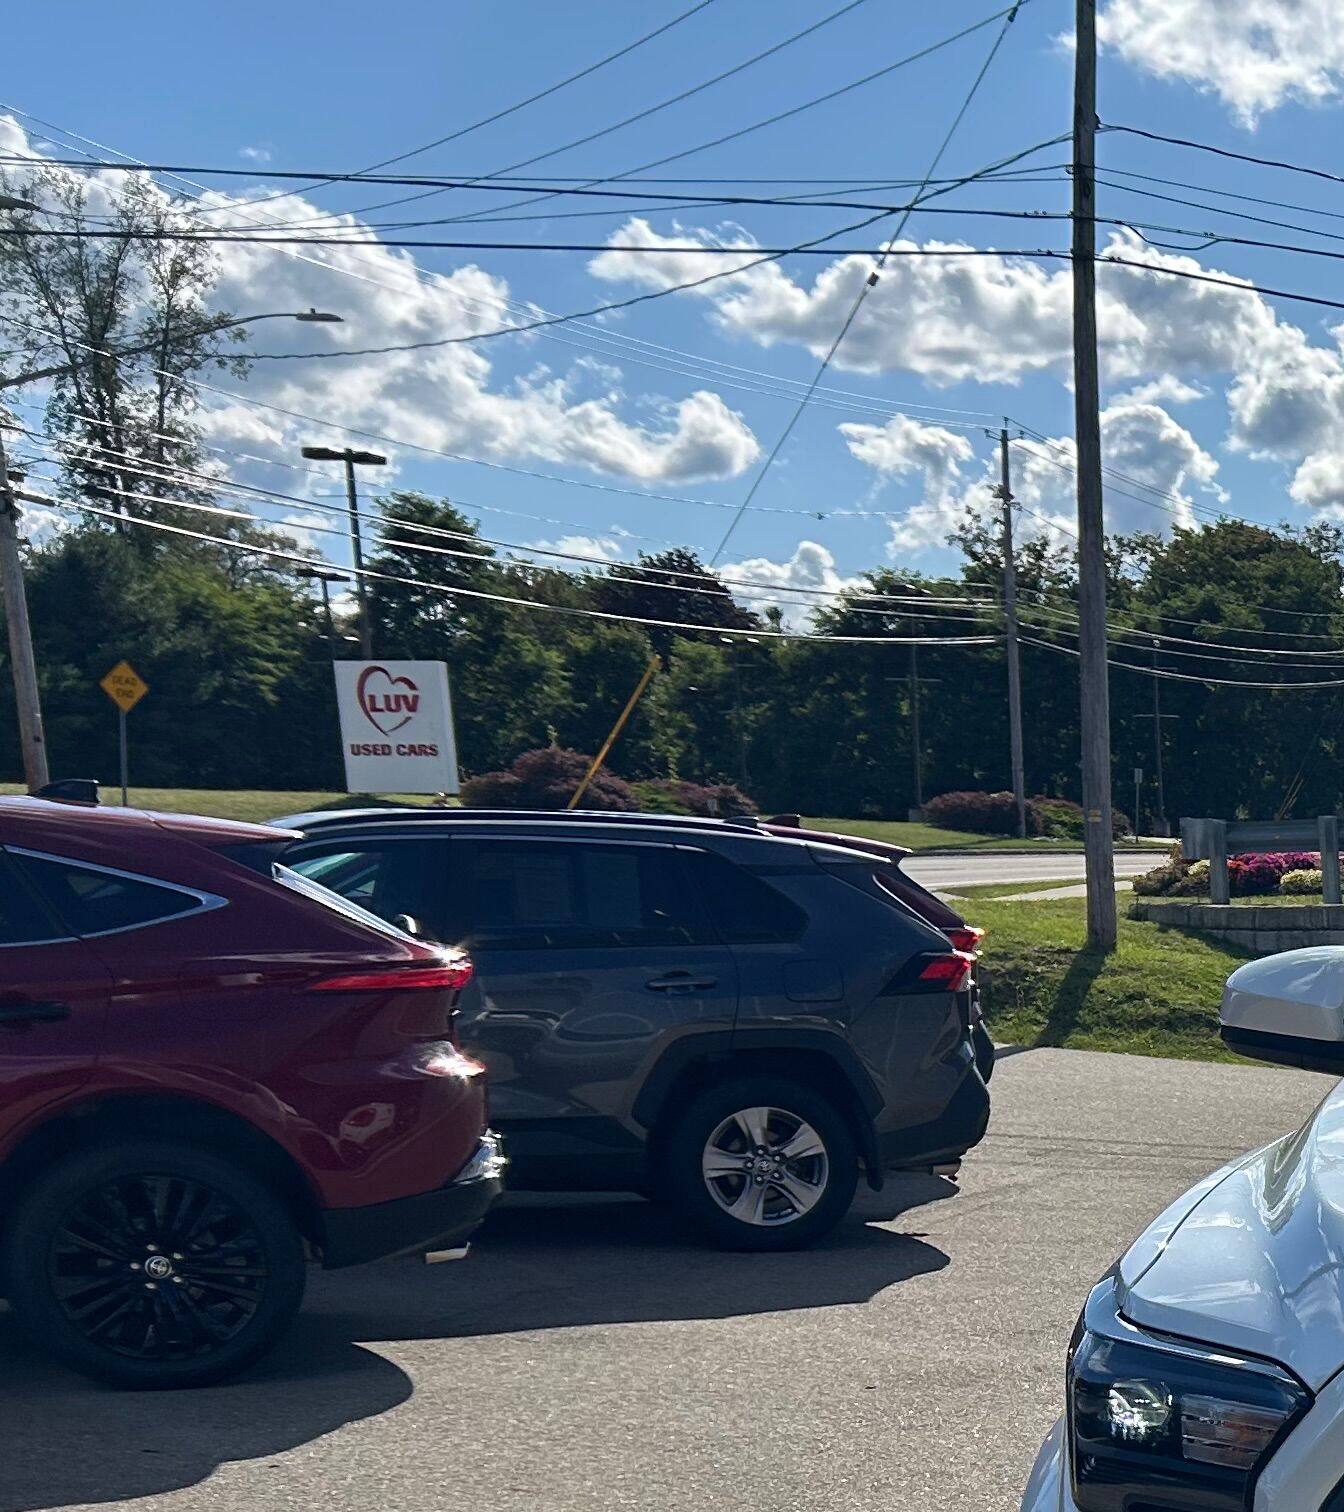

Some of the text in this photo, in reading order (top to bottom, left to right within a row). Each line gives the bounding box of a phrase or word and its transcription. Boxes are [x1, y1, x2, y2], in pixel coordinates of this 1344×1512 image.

[367, 694, 420, 713] LUV
[350, 743, 439, 757] USED CARS
